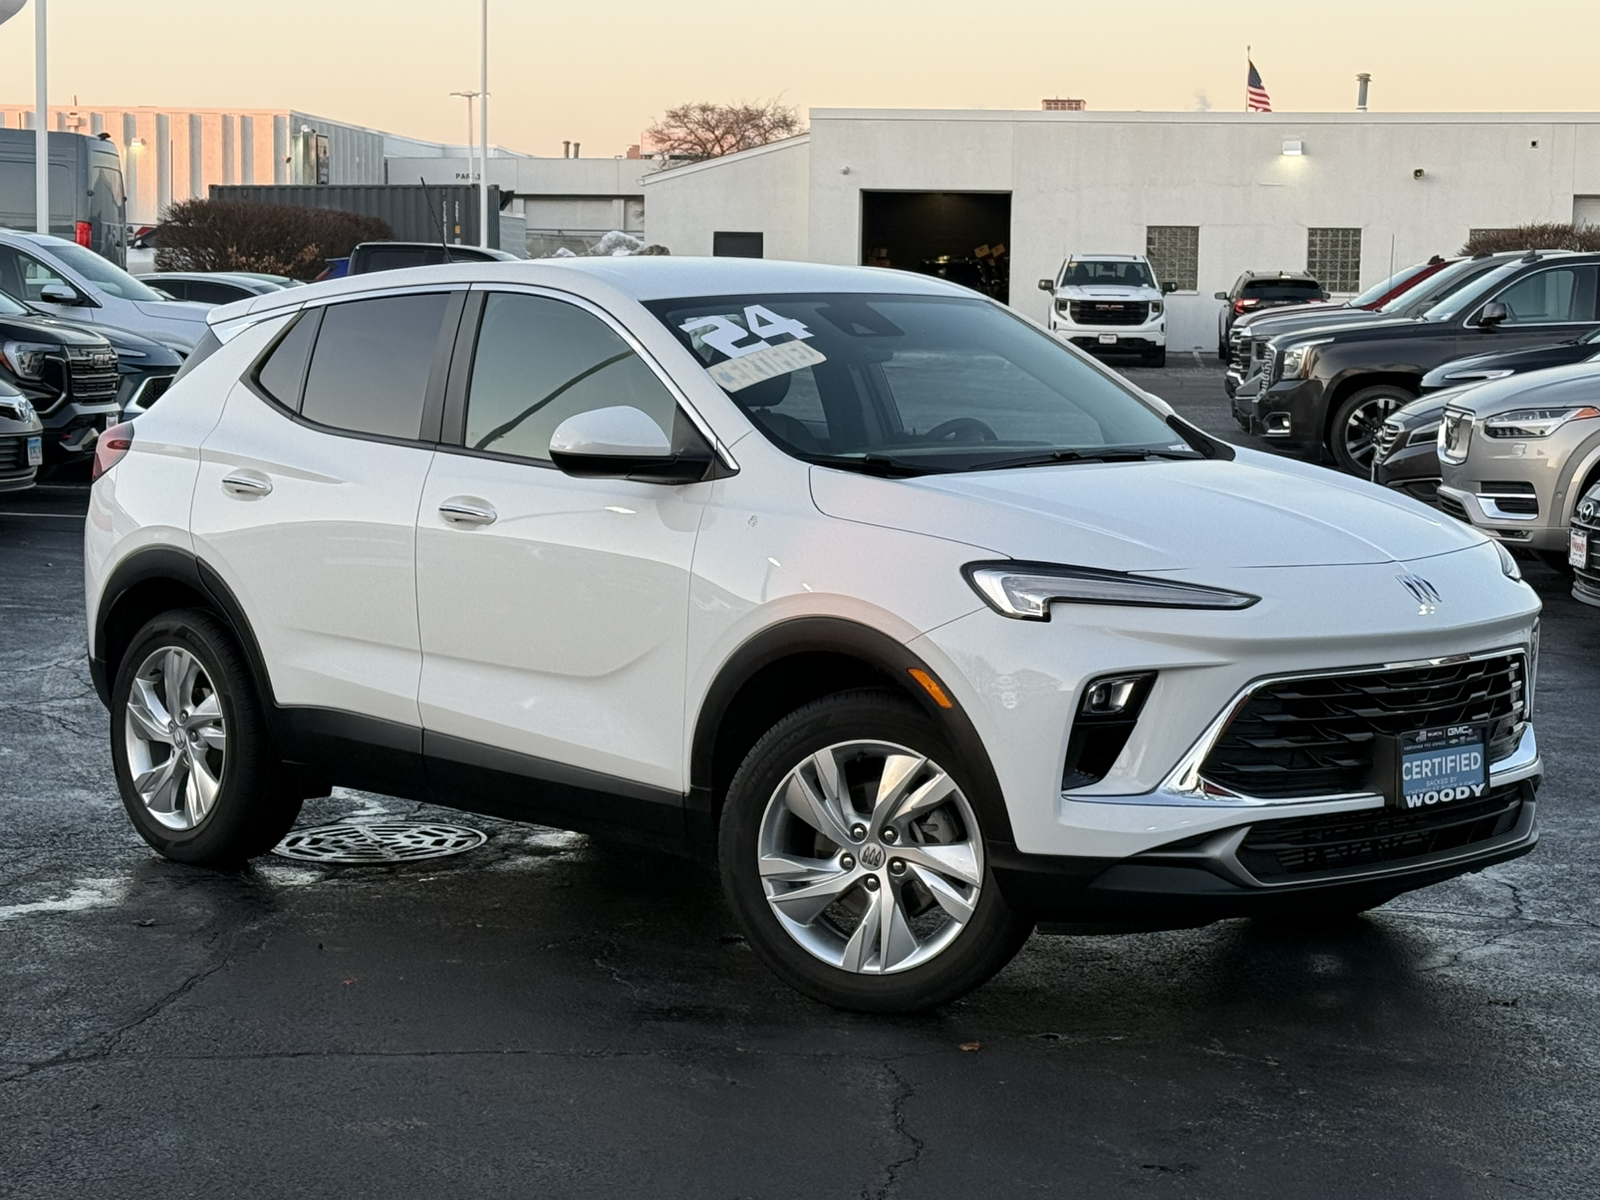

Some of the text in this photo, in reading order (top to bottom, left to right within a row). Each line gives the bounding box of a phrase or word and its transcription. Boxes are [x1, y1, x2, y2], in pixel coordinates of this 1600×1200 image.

[678, 304, 815, 359] 24
[1447, 726, 1469, 736] GMC
[1402, 752, 1480, 780] CERTIFIED
[1426, 777, 1449, 787] BACKED
[1405, 783, 1485, 808] WOODY
